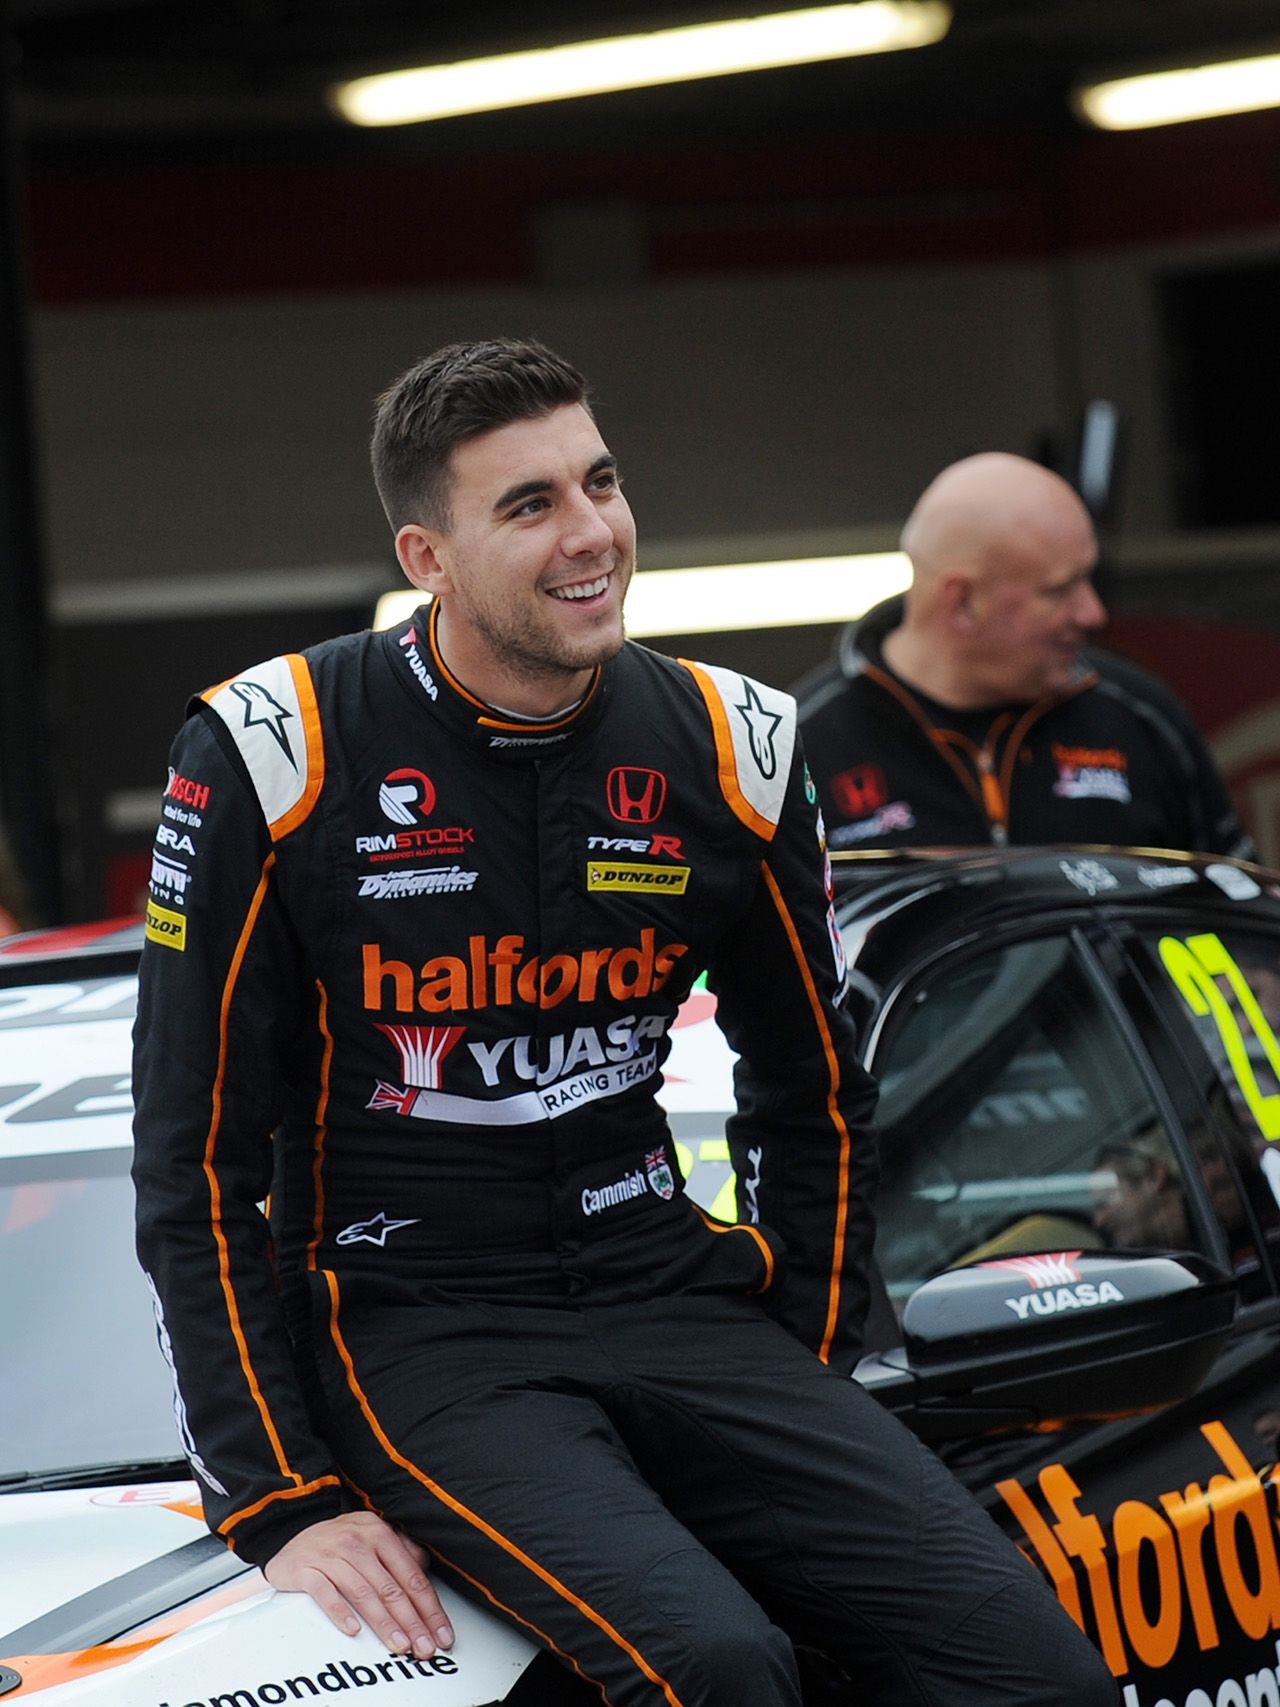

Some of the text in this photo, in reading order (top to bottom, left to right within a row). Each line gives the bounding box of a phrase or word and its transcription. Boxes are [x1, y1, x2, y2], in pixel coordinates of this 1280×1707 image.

[404, 649, 440, 702] YUASA
[355, 827, 476, 854] RIMSTOCK
[587, 834, 687, 860] TYPE R
[602, 869, 684, 887] DUNLOP
[362, 928, 689, 1013] halfords
[467, 1014, 670, 1087] YUASA
[543, 1074, 610, 1112] RACING
[581, 1170, 649, 1216] Cammish
[1005, 1281, 1124, 1320] YUASA
